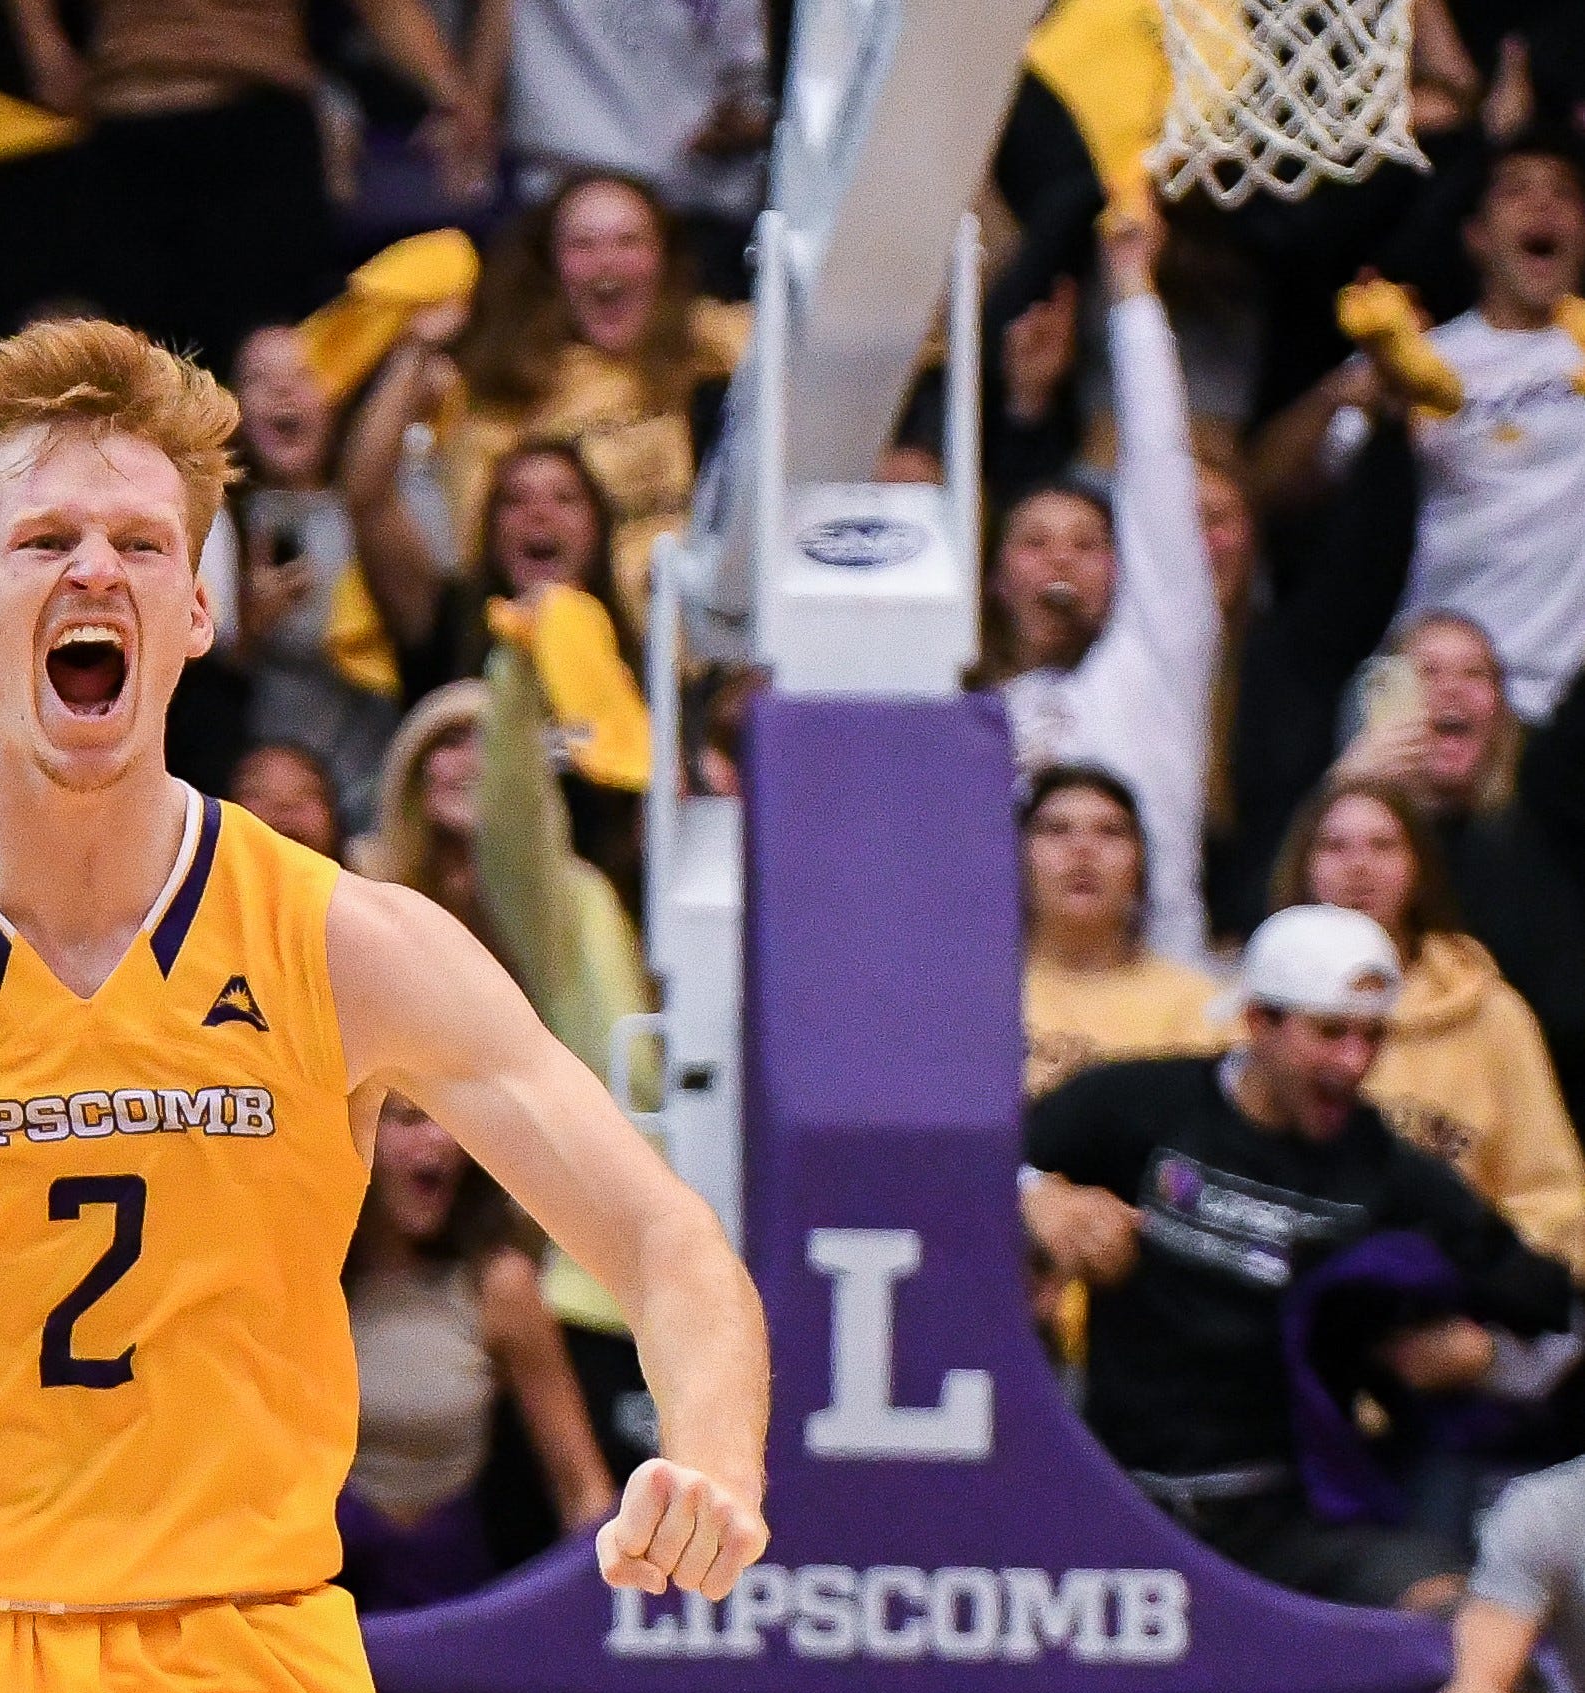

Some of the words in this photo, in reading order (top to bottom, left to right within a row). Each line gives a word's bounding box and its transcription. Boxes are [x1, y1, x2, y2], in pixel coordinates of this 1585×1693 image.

[39, 1173, 147, 1388] 2
[804, 1228, 994, 1460] L
[605, 1563, 1191, 1664] LIPSCOMB
